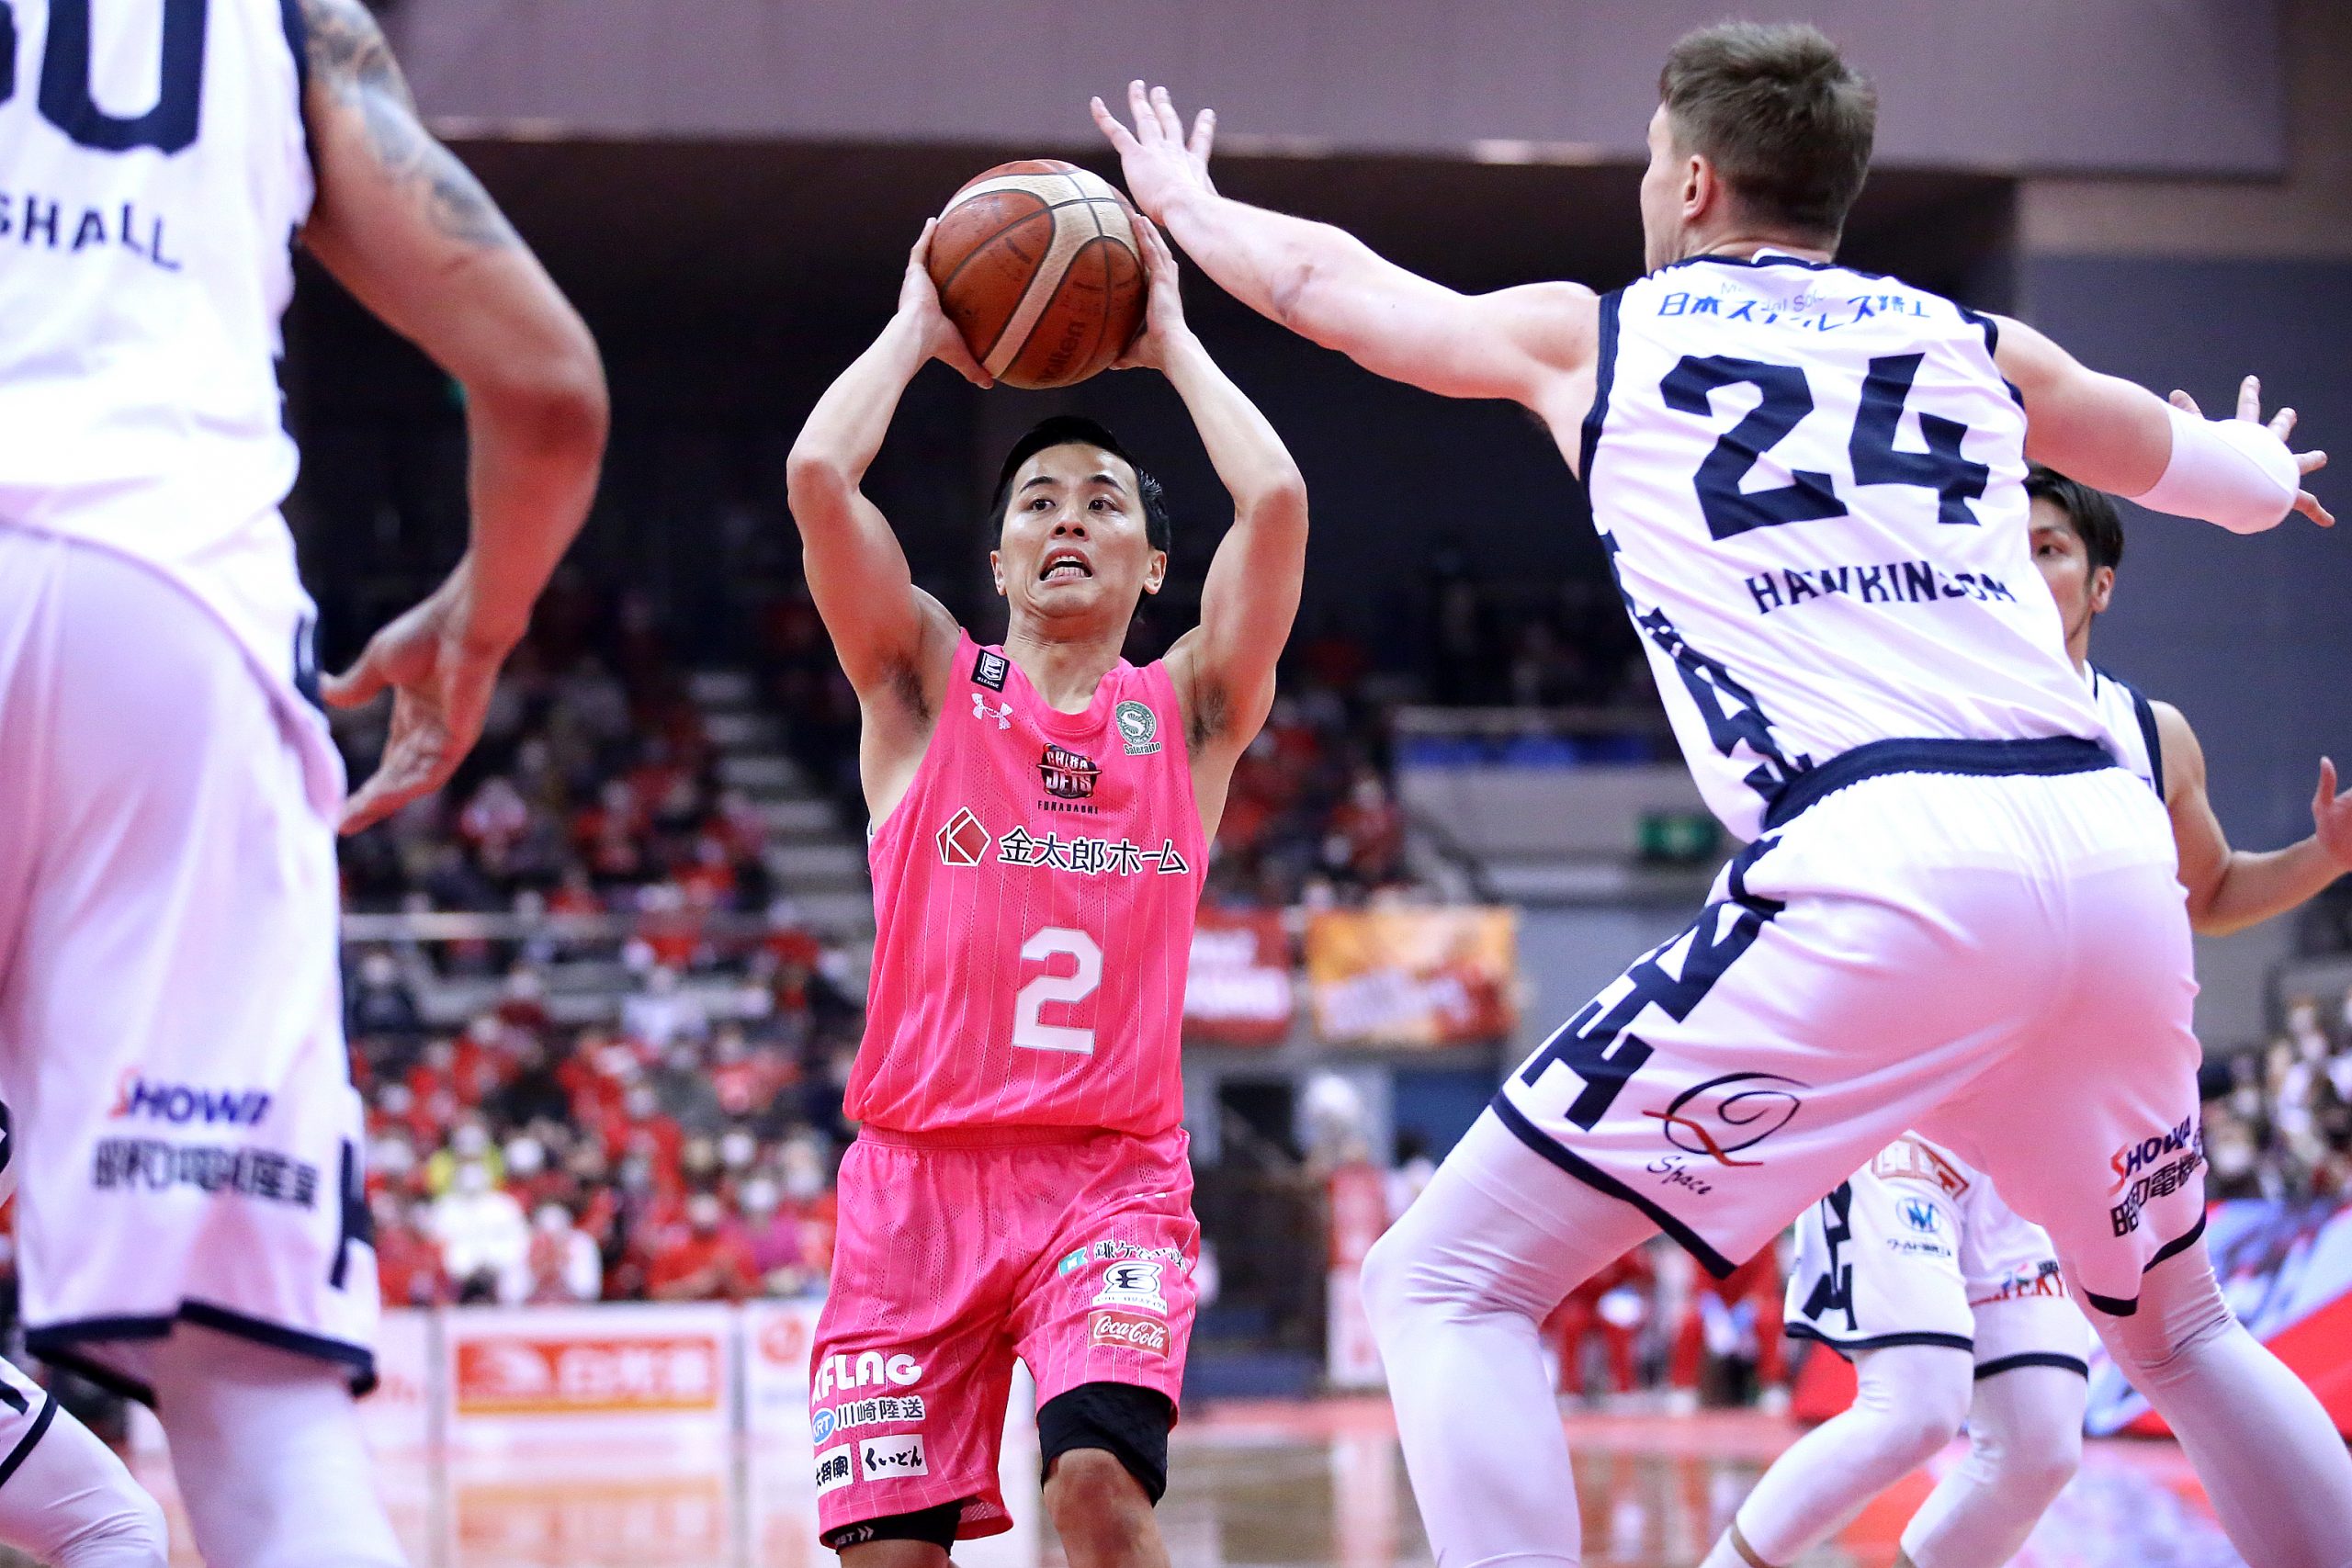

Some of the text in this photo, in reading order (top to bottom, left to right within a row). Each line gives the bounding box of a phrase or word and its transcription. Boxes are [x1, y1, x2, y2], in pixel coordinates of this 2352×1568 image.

[0, 0, 209, 156] 0
[1659, 352, 1990, 541] 24
[1000, 827, 1188, 874] 金太郎ホーム
[1012, 926, 1103, 1055] 2
[1646, 1155, 1713, 1195] Space
[1092, 1315, 1165, 1349] Coca-Cola
[811, 1351, 923, 1406] XFLAG
[837, 1398, 924, 1429] 川崎陸送
[865, 1445, 922, 1472] くいどん
